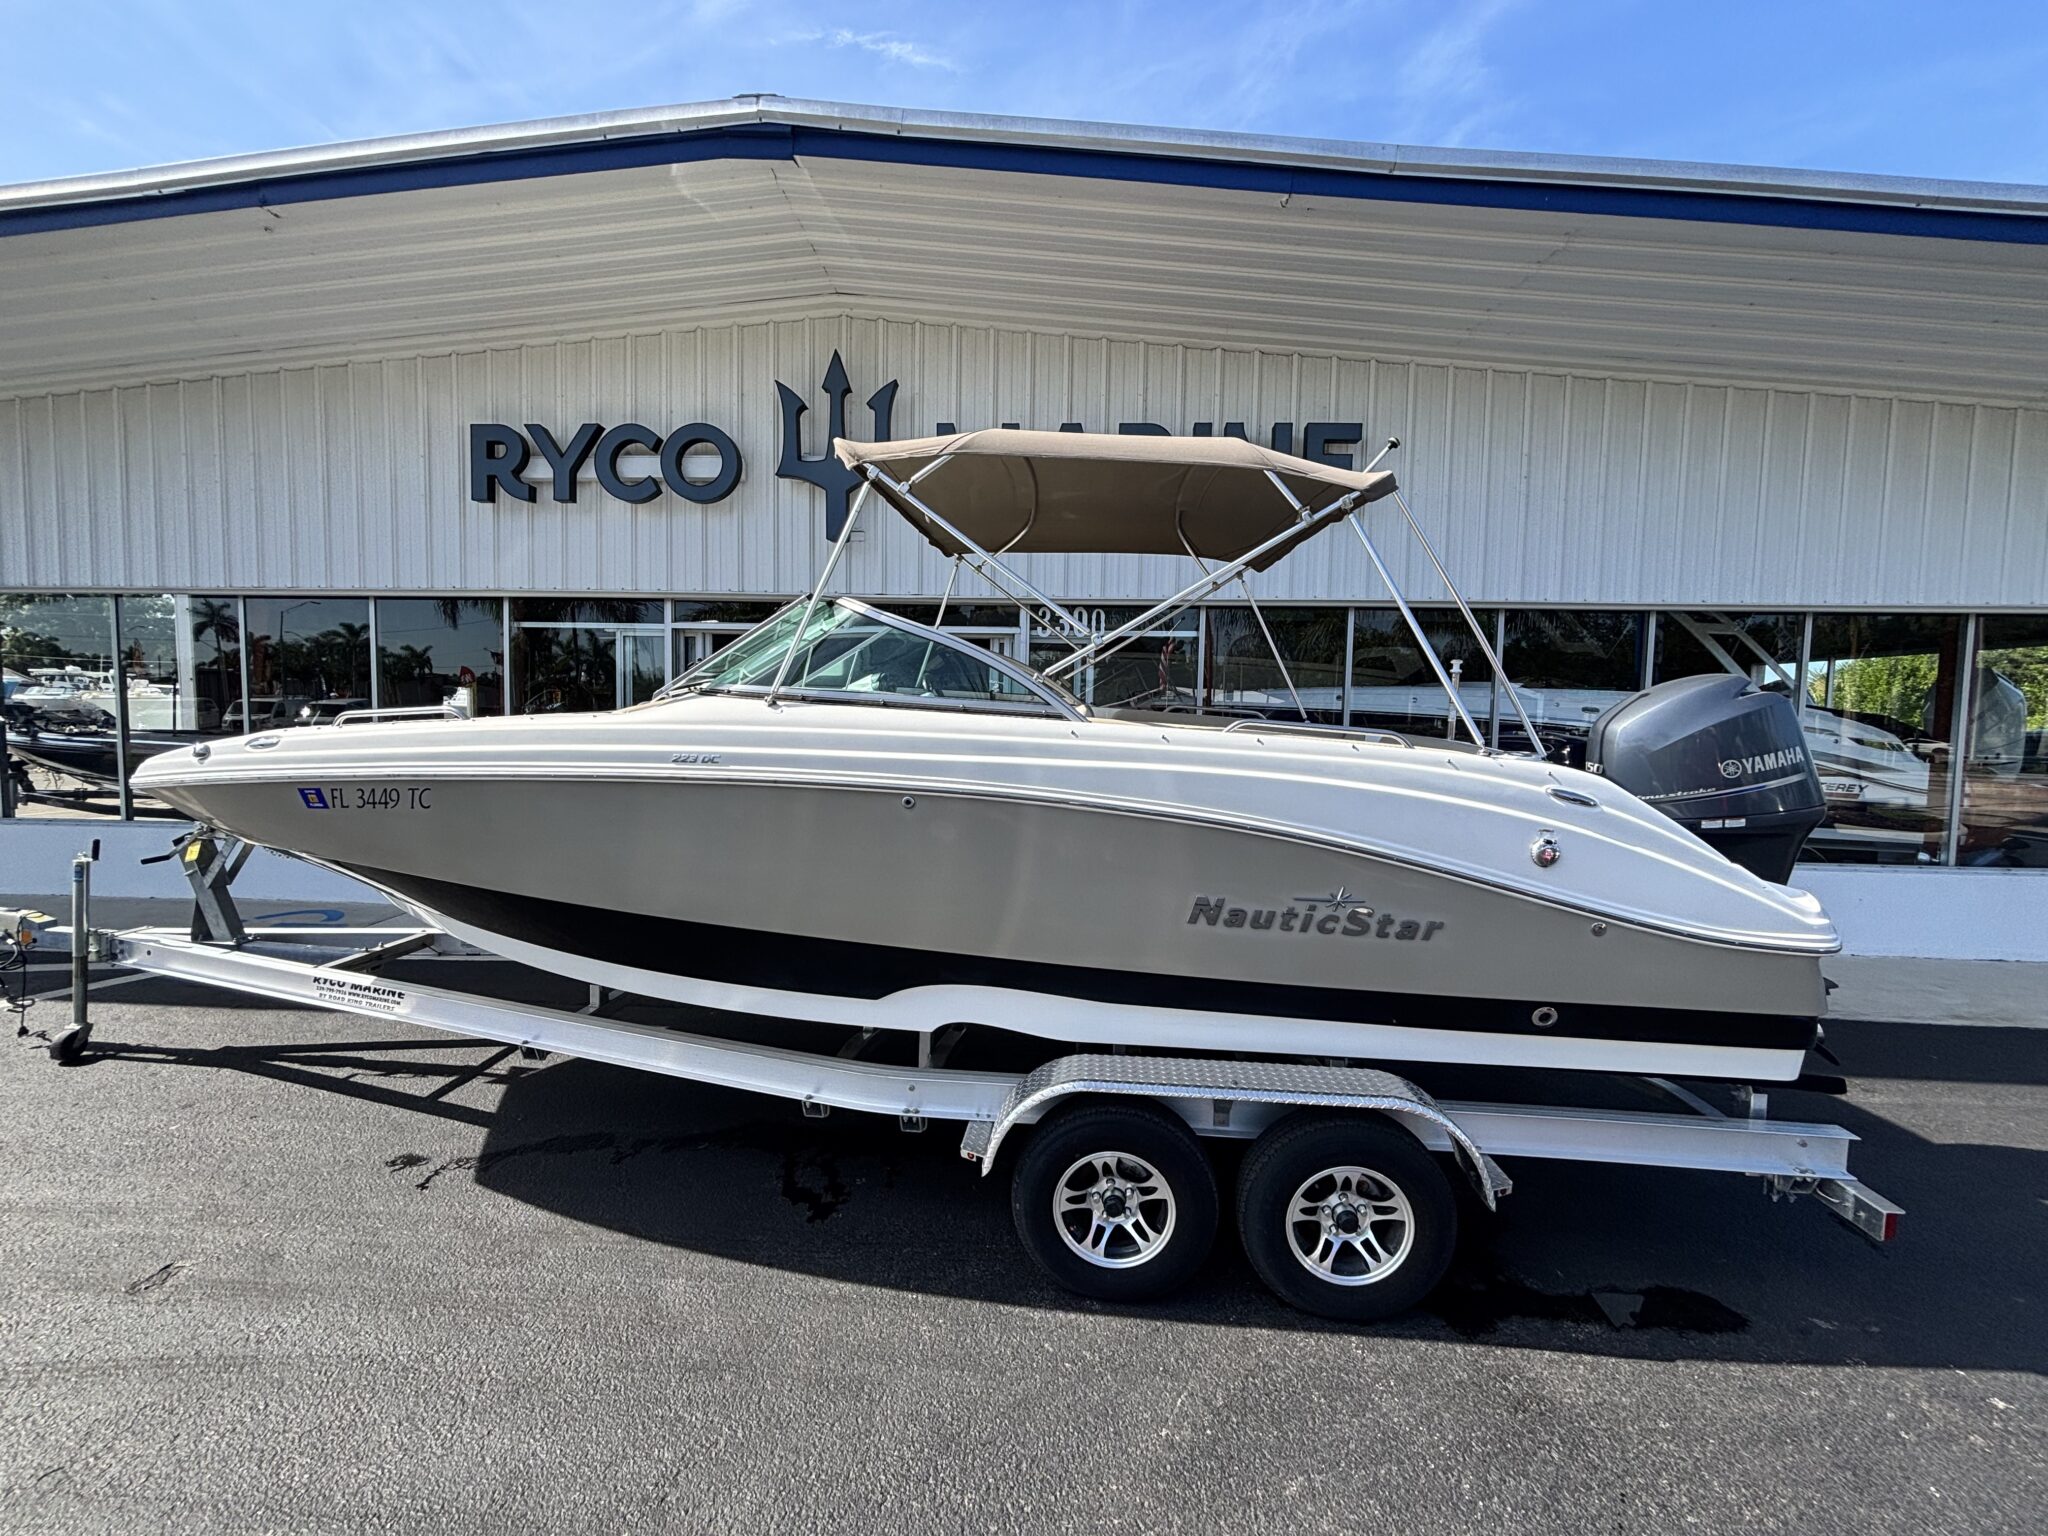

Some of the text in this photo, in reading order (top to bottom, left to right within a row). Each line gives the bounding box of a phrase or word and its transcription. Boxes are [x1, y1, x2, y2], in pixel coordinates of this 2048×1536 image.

[470, 423, 743, 504] RYCO
[1037, 606, 1105, 637] 3300
[671, 753, 721, 765] 223 DC
[1741, 746, 1805, 774] YAMAHA
[330, 788, 350, 809] FL
[356, 788, 400, 809] 3449
[407, 788, 432, 809] TC
[1187, 896, 1444, 941] NauticStar
[328, 993, 346, 1002] ROAD
[364, 1001, 396, 1012] TRAILERS
